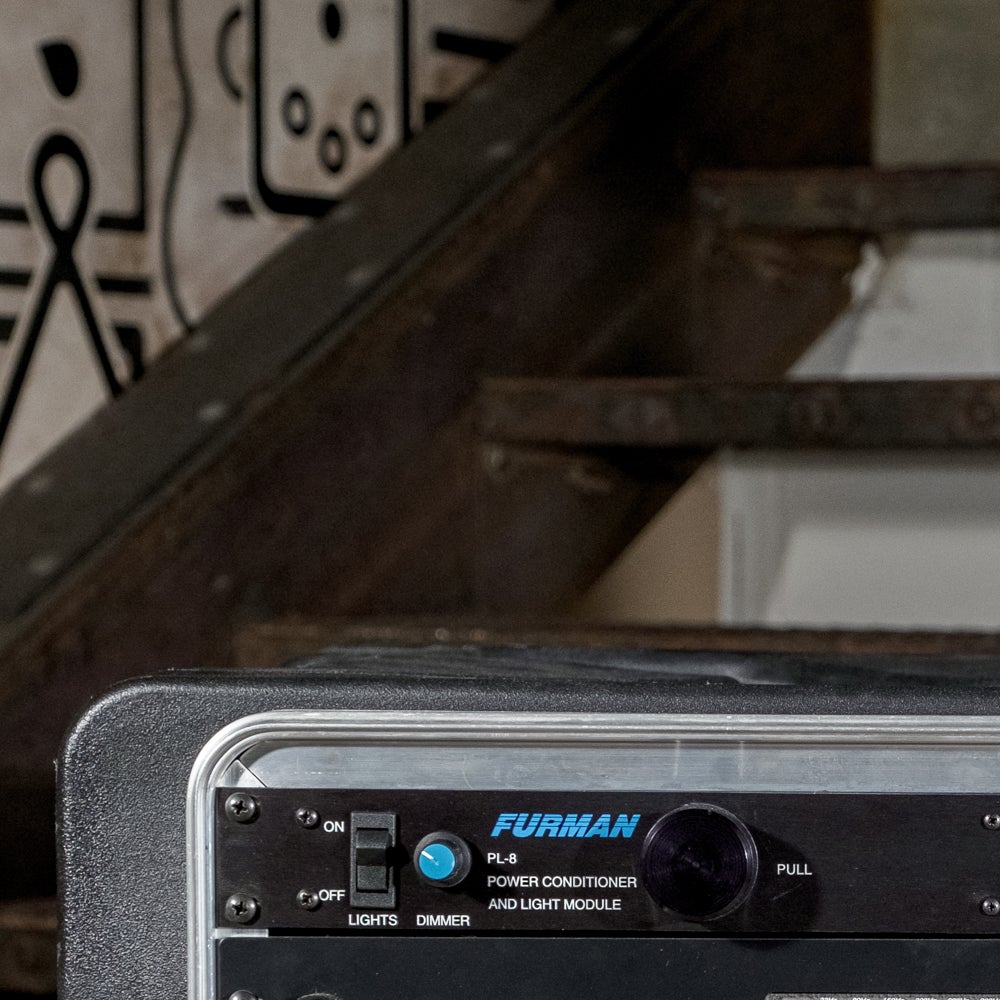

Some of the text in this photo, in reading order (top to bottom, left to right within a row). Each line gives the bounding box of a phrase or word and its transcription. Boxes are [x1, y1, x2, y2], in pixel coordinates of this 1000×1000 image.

[323, 820, 345, 833] ON
[490, 812, 641, 838] FURMAN
[487, 852, 517, 865] PL-8
[777, 863, 813, 876] PULL
[487, 875, 638, 888] POWER CONDITIONER
[318, 889, 346, 902] OFF
[488, 898, 622, 911] AND LIGHT MODULE
[348, 913, 398, 926] LIGHTS
[416, 914, 470, 927] DIMMER
